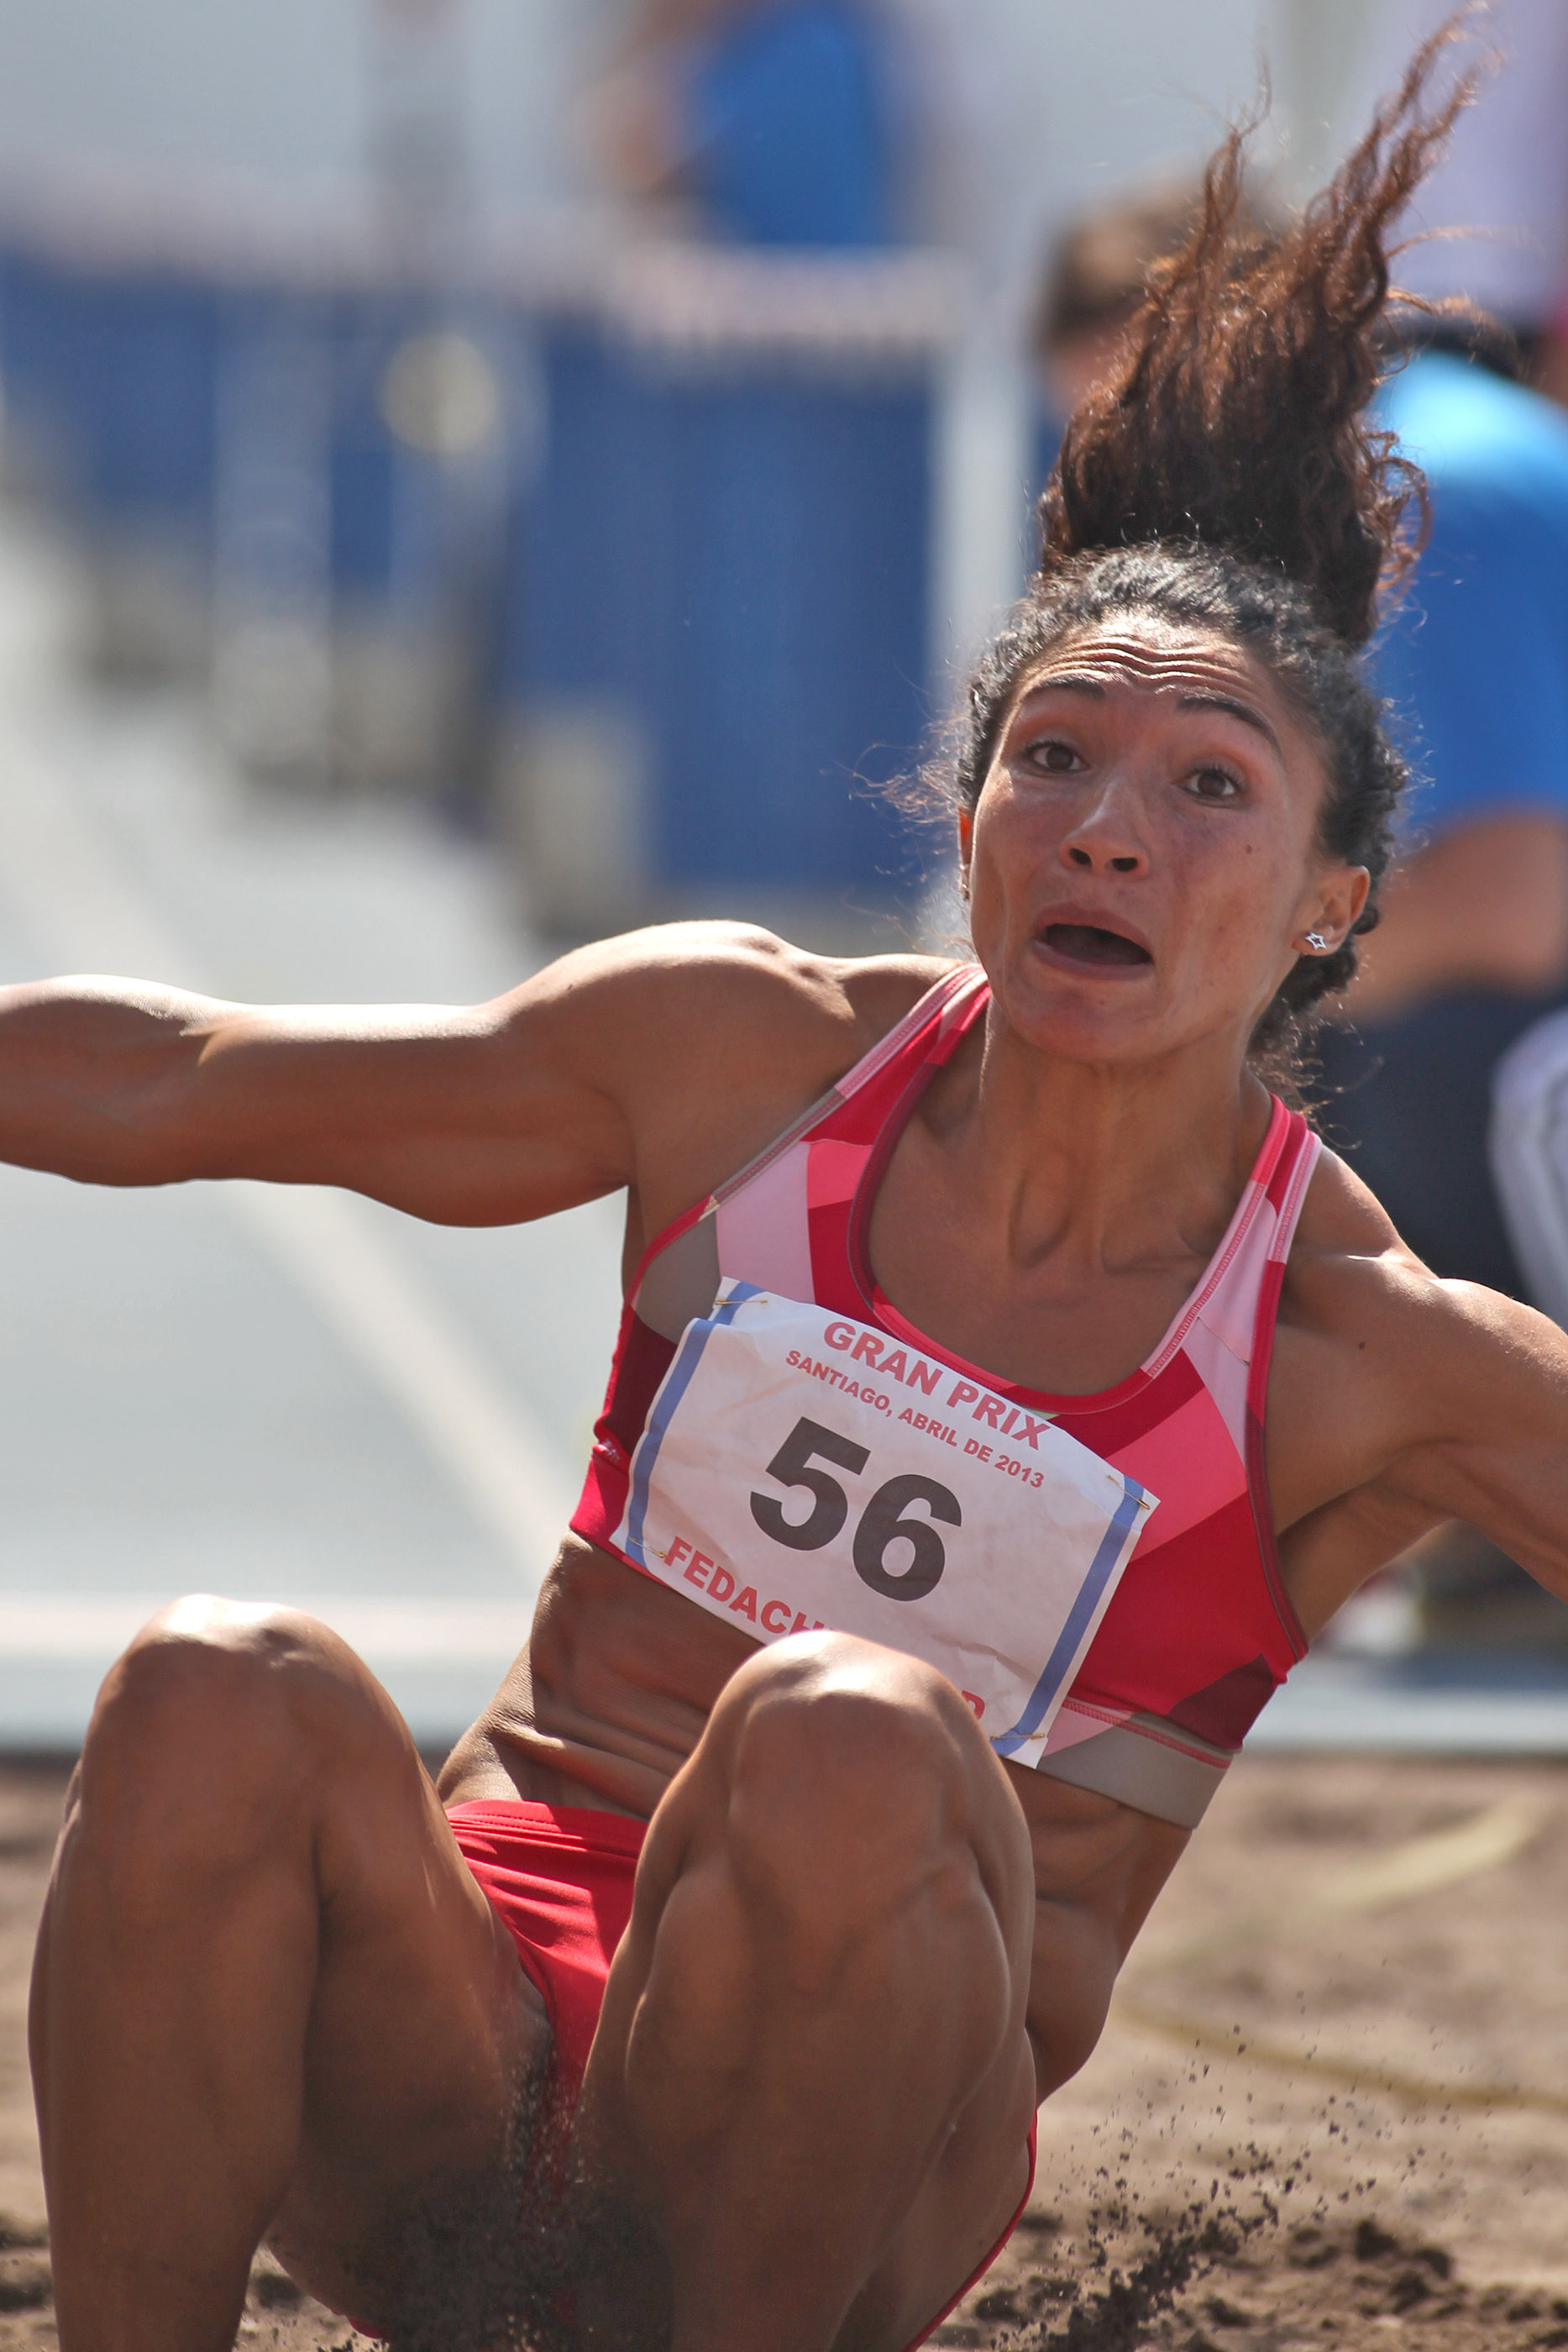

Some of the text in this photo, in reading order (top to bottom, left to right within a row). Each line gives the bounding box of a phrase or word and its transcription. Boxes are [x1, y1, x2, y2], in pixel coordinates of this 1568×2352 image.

[785, 1350, 1046, 1488] SANTIAGO, ABRIL DE 2013
[823, 1321, 1051, 1451] GRAN PRIX
[749, 1416, 963, 1602] 56
